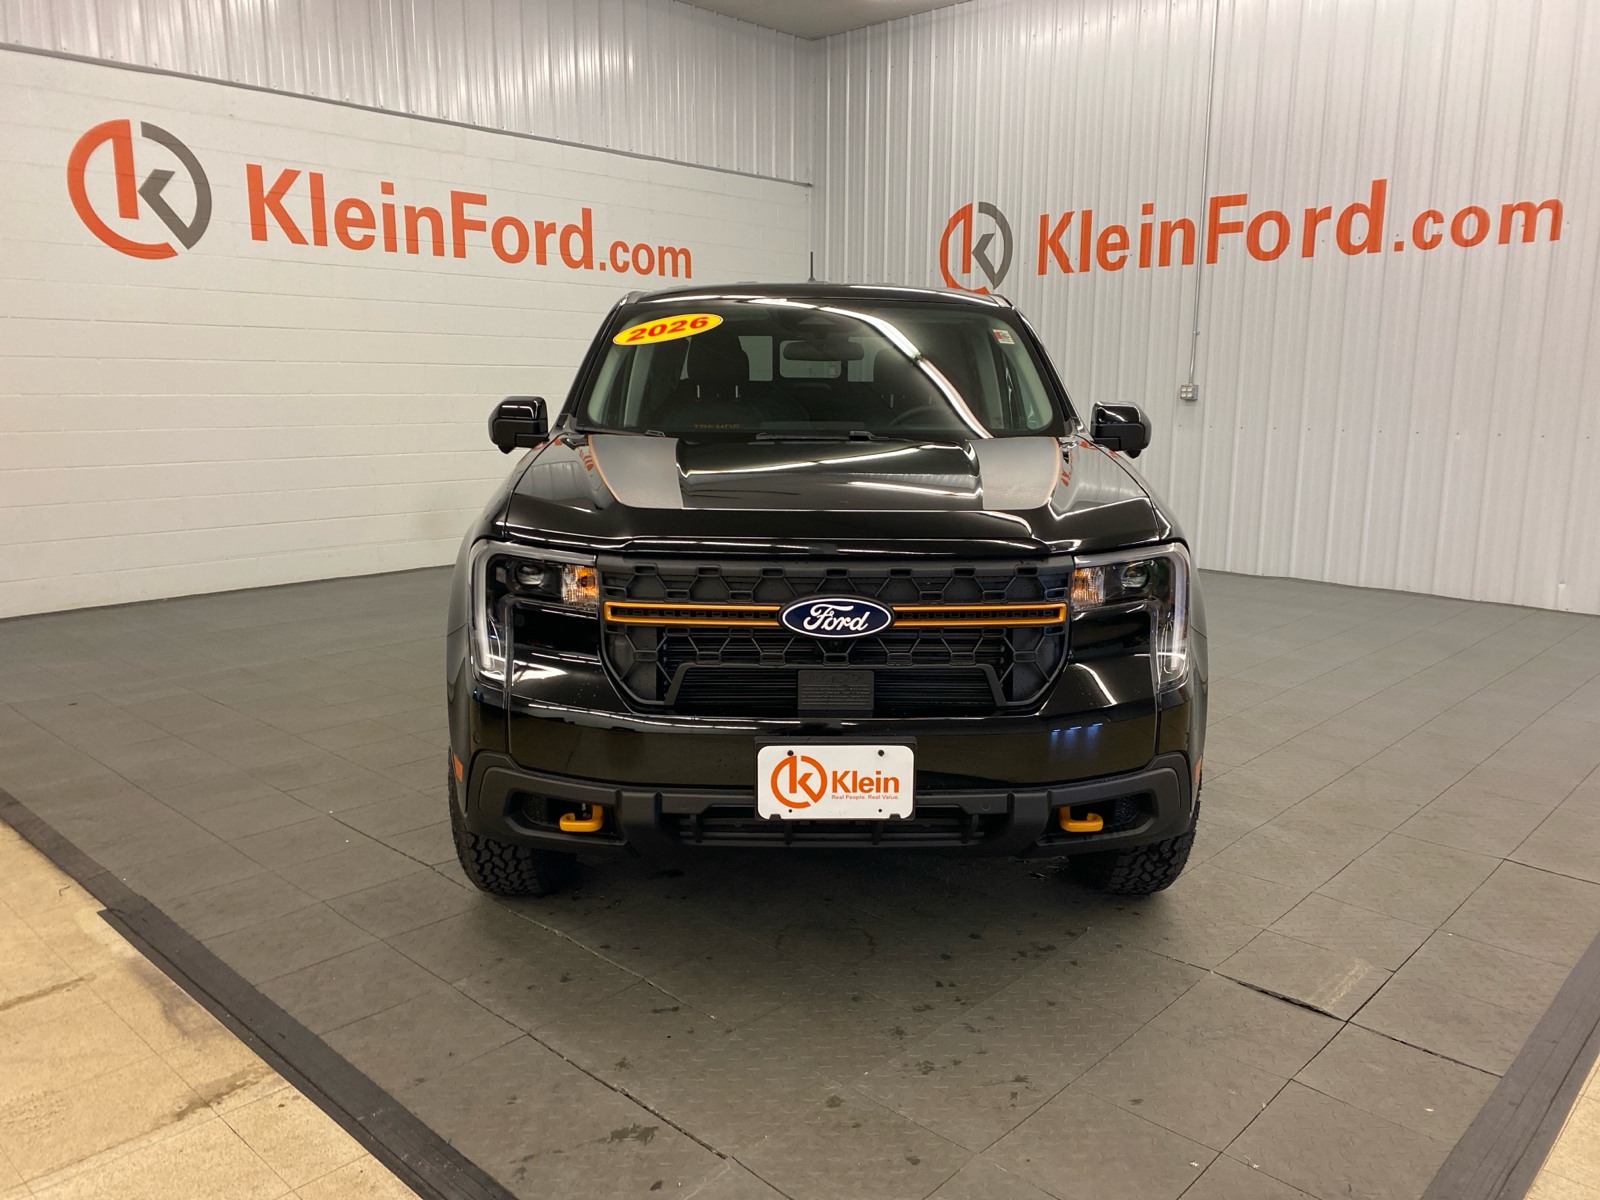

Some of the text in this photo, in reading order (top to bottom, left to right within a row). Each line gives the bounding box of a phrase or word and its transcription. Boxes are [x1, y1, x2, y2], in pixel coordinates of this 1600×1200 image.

[246, 163, 692, 280] KleinFord.com
[1037, 178, 1563, 277] KleinFord.com
[626, 316, 710, 342] 2026
[803, 603, 871, 631] Ford
[831, 770, 900, 793] Klein
